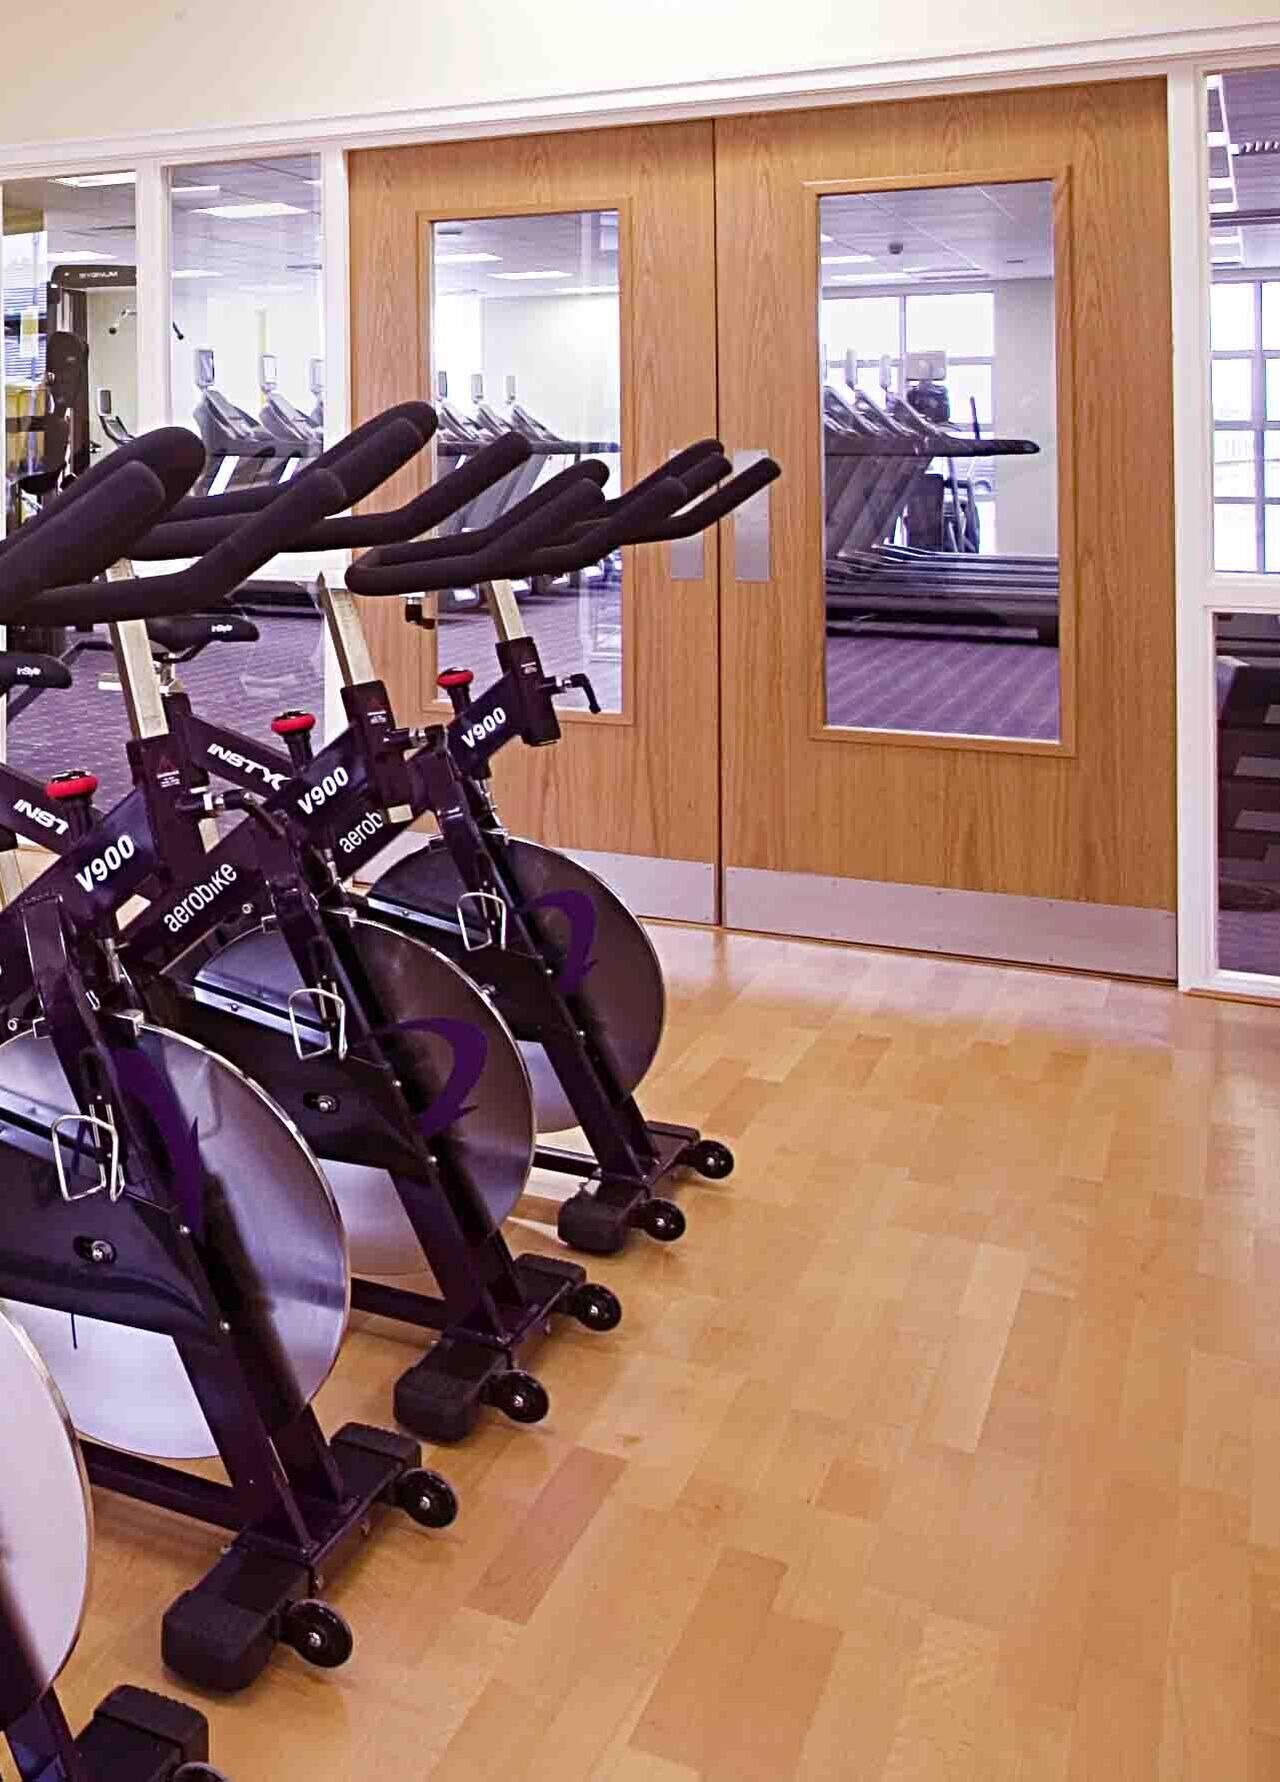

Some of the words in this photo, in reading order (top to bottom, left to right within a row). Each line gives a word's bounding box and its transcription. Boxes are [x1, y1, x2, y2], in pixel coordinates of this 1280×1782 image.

[461, 707, 507, 749] V900
[206, 743, 292, 791] INSTY
[297, 766, 350, 815] V900
[339, 809, 385, 855] aerob
[74, 834, 135, 893] V900
[163, 863, 237, 933] aerobike
